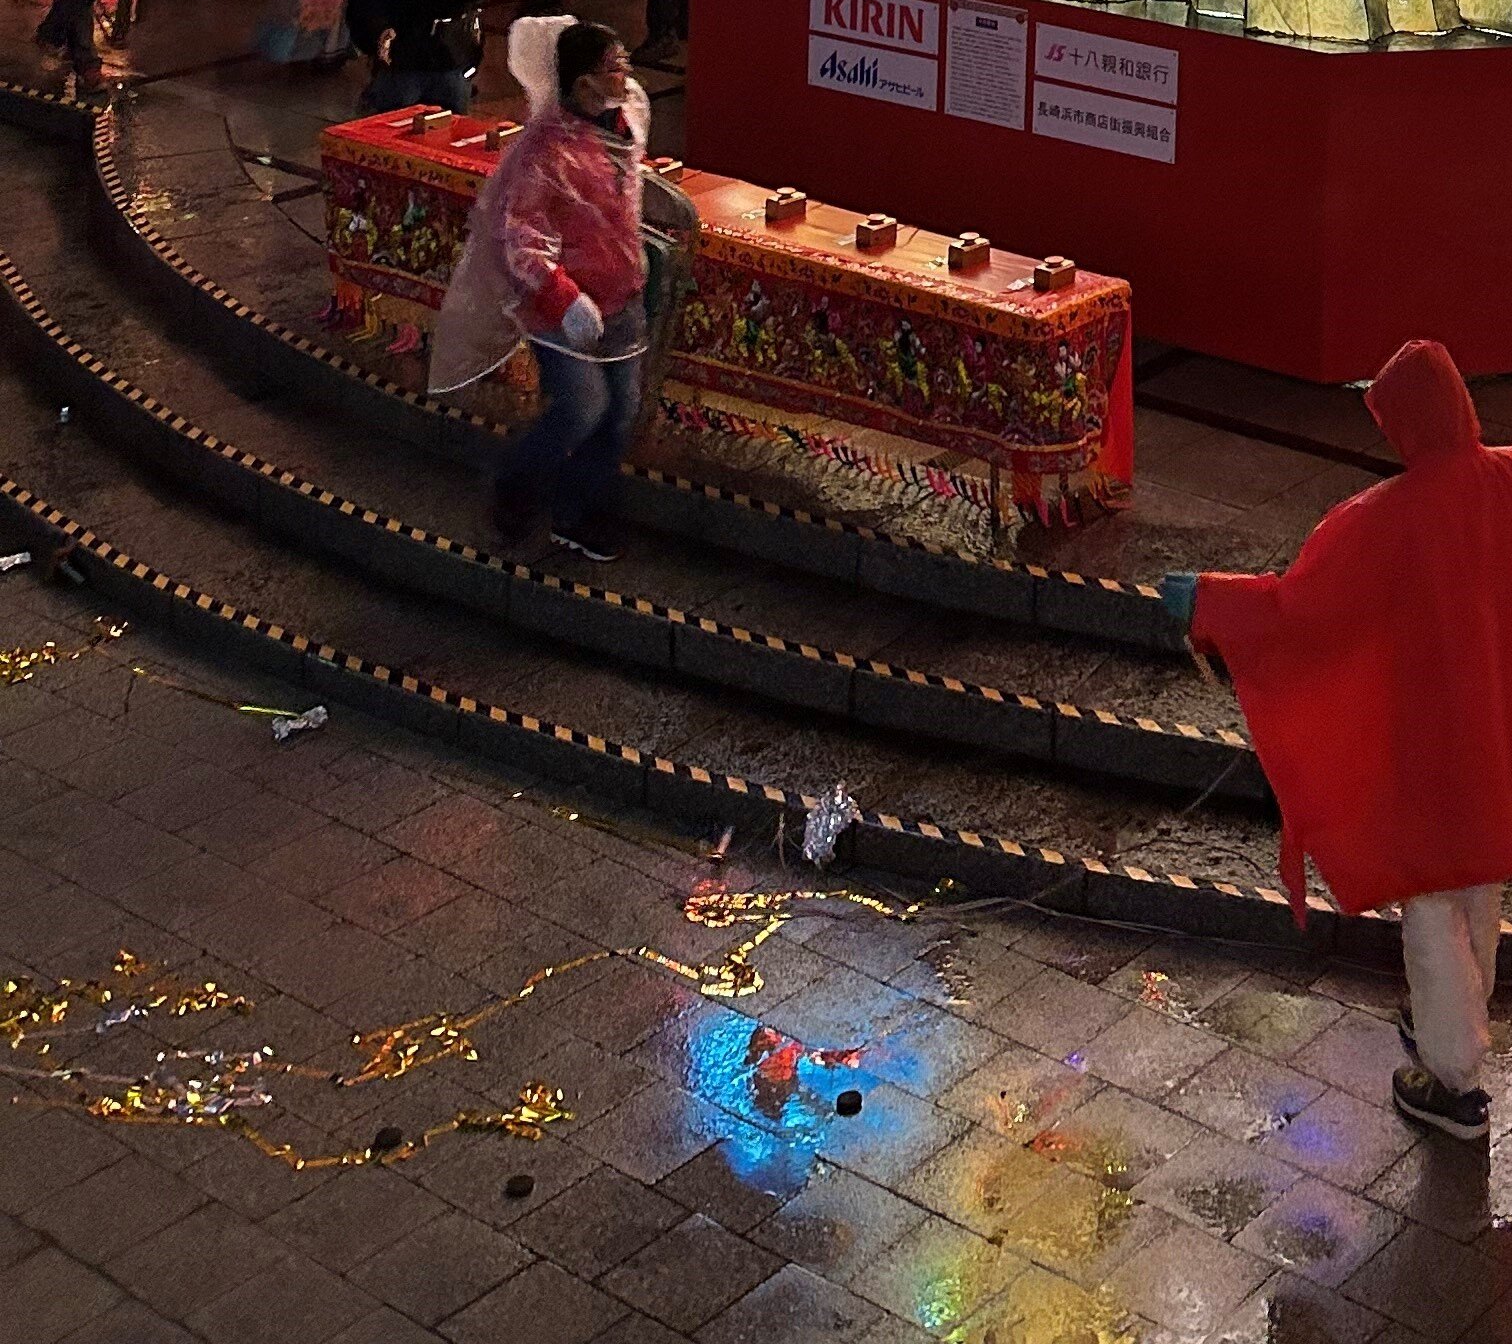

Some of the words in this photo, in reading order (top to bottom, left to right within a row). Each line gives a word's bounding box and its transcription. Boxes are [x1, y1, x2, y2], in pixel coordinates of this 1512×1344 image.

[820, 50, 878, 88] Asahi
[879, 78, 924, 97] アサヒビール
[1069, 47, 1169, 85] 十八親和銀行
